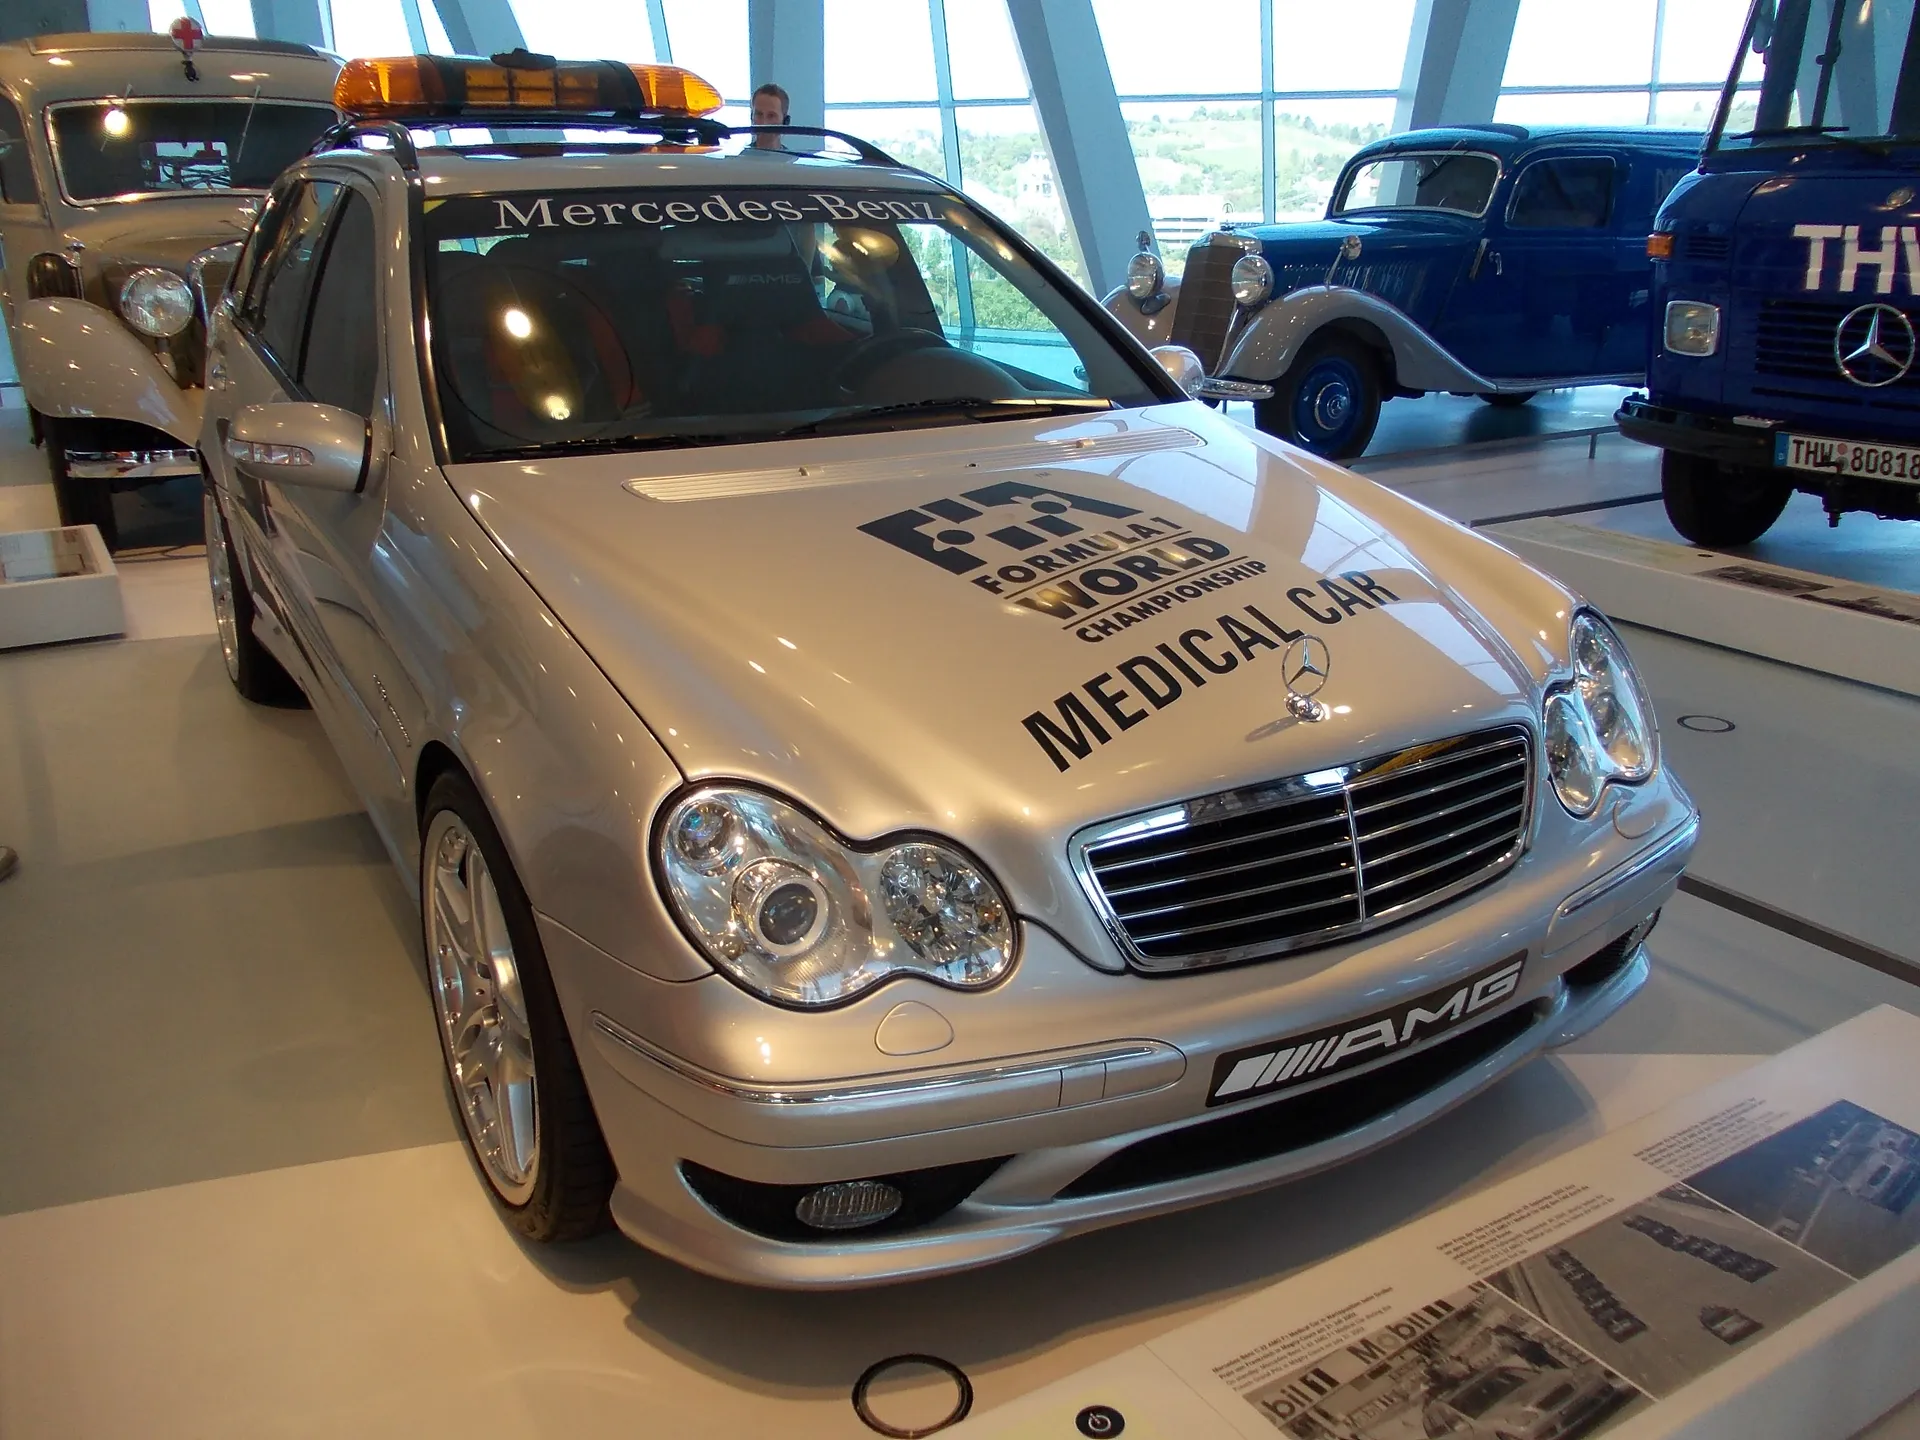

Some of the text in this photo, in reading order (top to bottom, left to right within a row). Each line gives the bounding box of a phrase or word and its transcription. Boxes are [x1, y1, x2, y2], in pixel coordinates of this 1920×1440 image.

[494, 194, 947, 229] Mercedes-Benz
[1850, 446, 1920, 480] 80818
[971, 516, 1182, 595] FORMULA 1
[1012, 537, 1230, 619] WORLD
[1075, 561, 1268, 644] CHAMPIONSHIP
[1020, 570, 1401, 773] MEDICAL CAR
[1320, 960, 1522, 1069] AMG
[1346, 1311, 1432, 1365] Mobil
